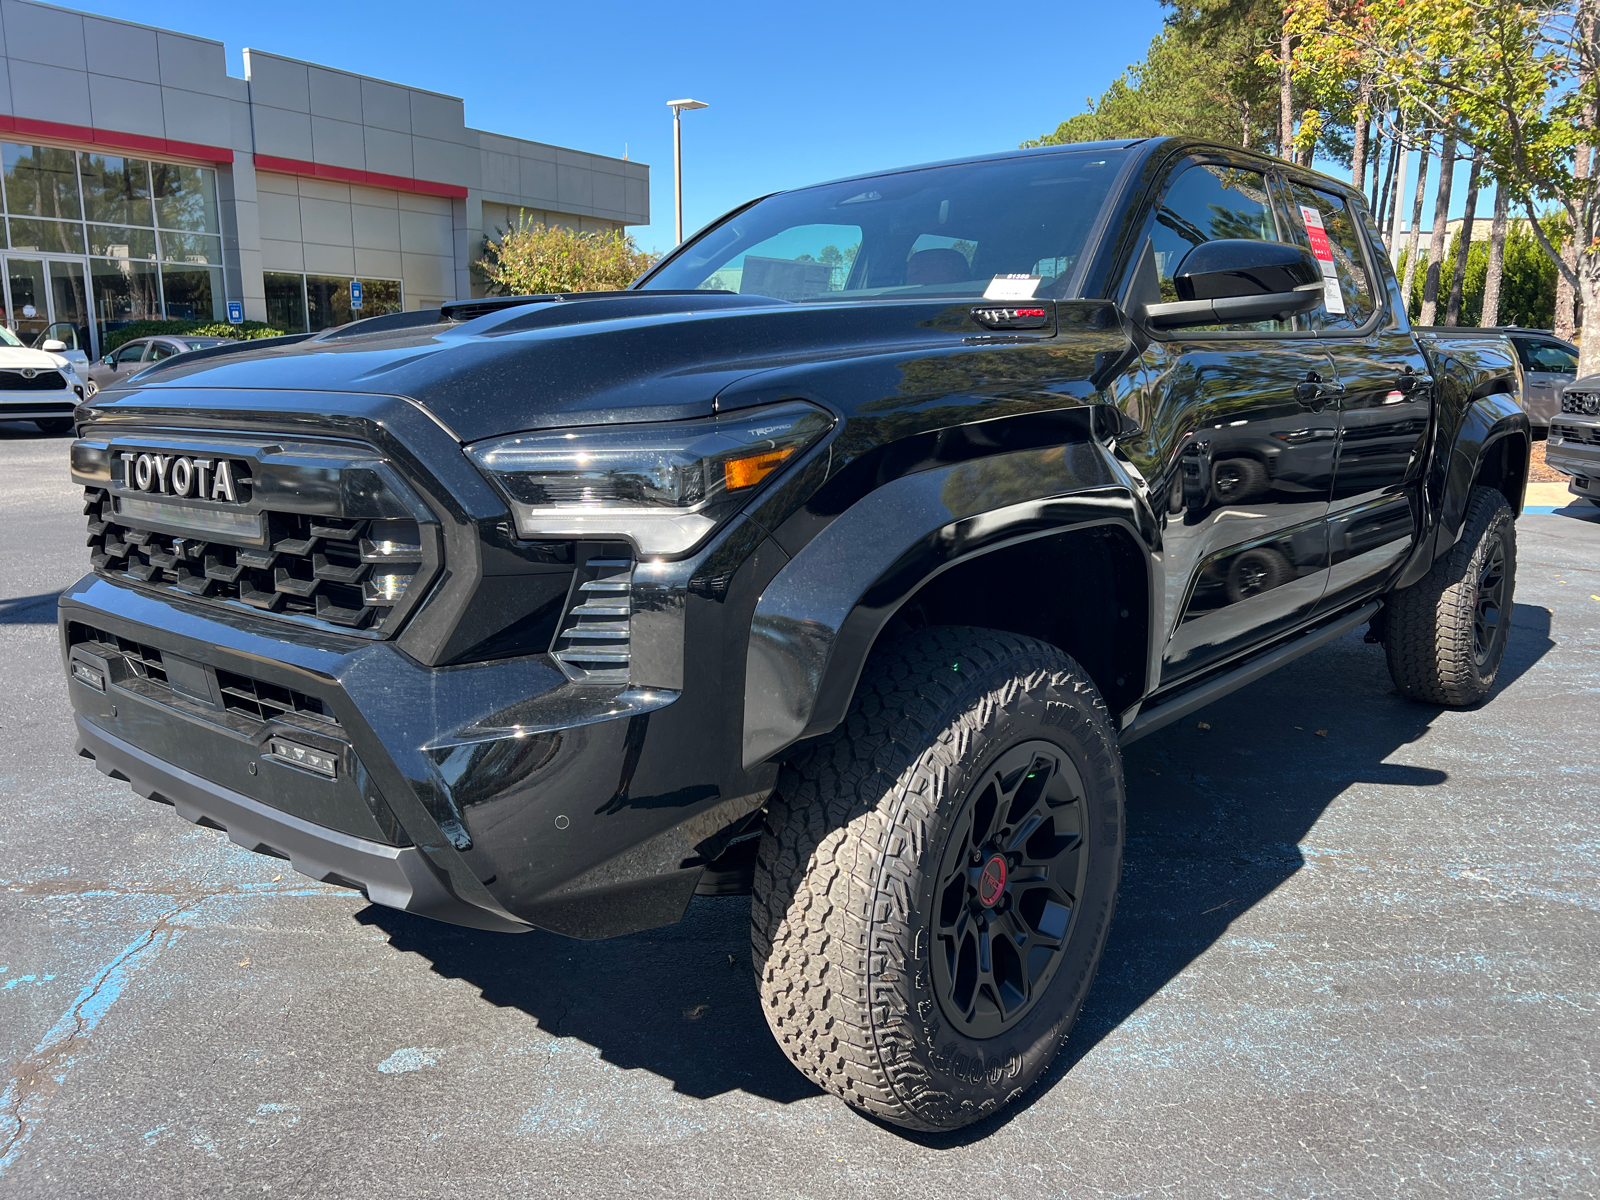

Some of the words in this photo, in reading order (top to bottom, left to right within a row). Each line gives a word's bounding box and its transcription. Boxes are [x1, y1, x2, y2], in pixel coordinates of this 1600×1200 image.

[747, 426, 774, 436] TRD
[773, 423, 793, 431] PRO
[121, 452, 237, 502] TOYOTA
[1040, 700, 1118, 848] WRANGLER
[983, 869, 1000, 889] TRD
